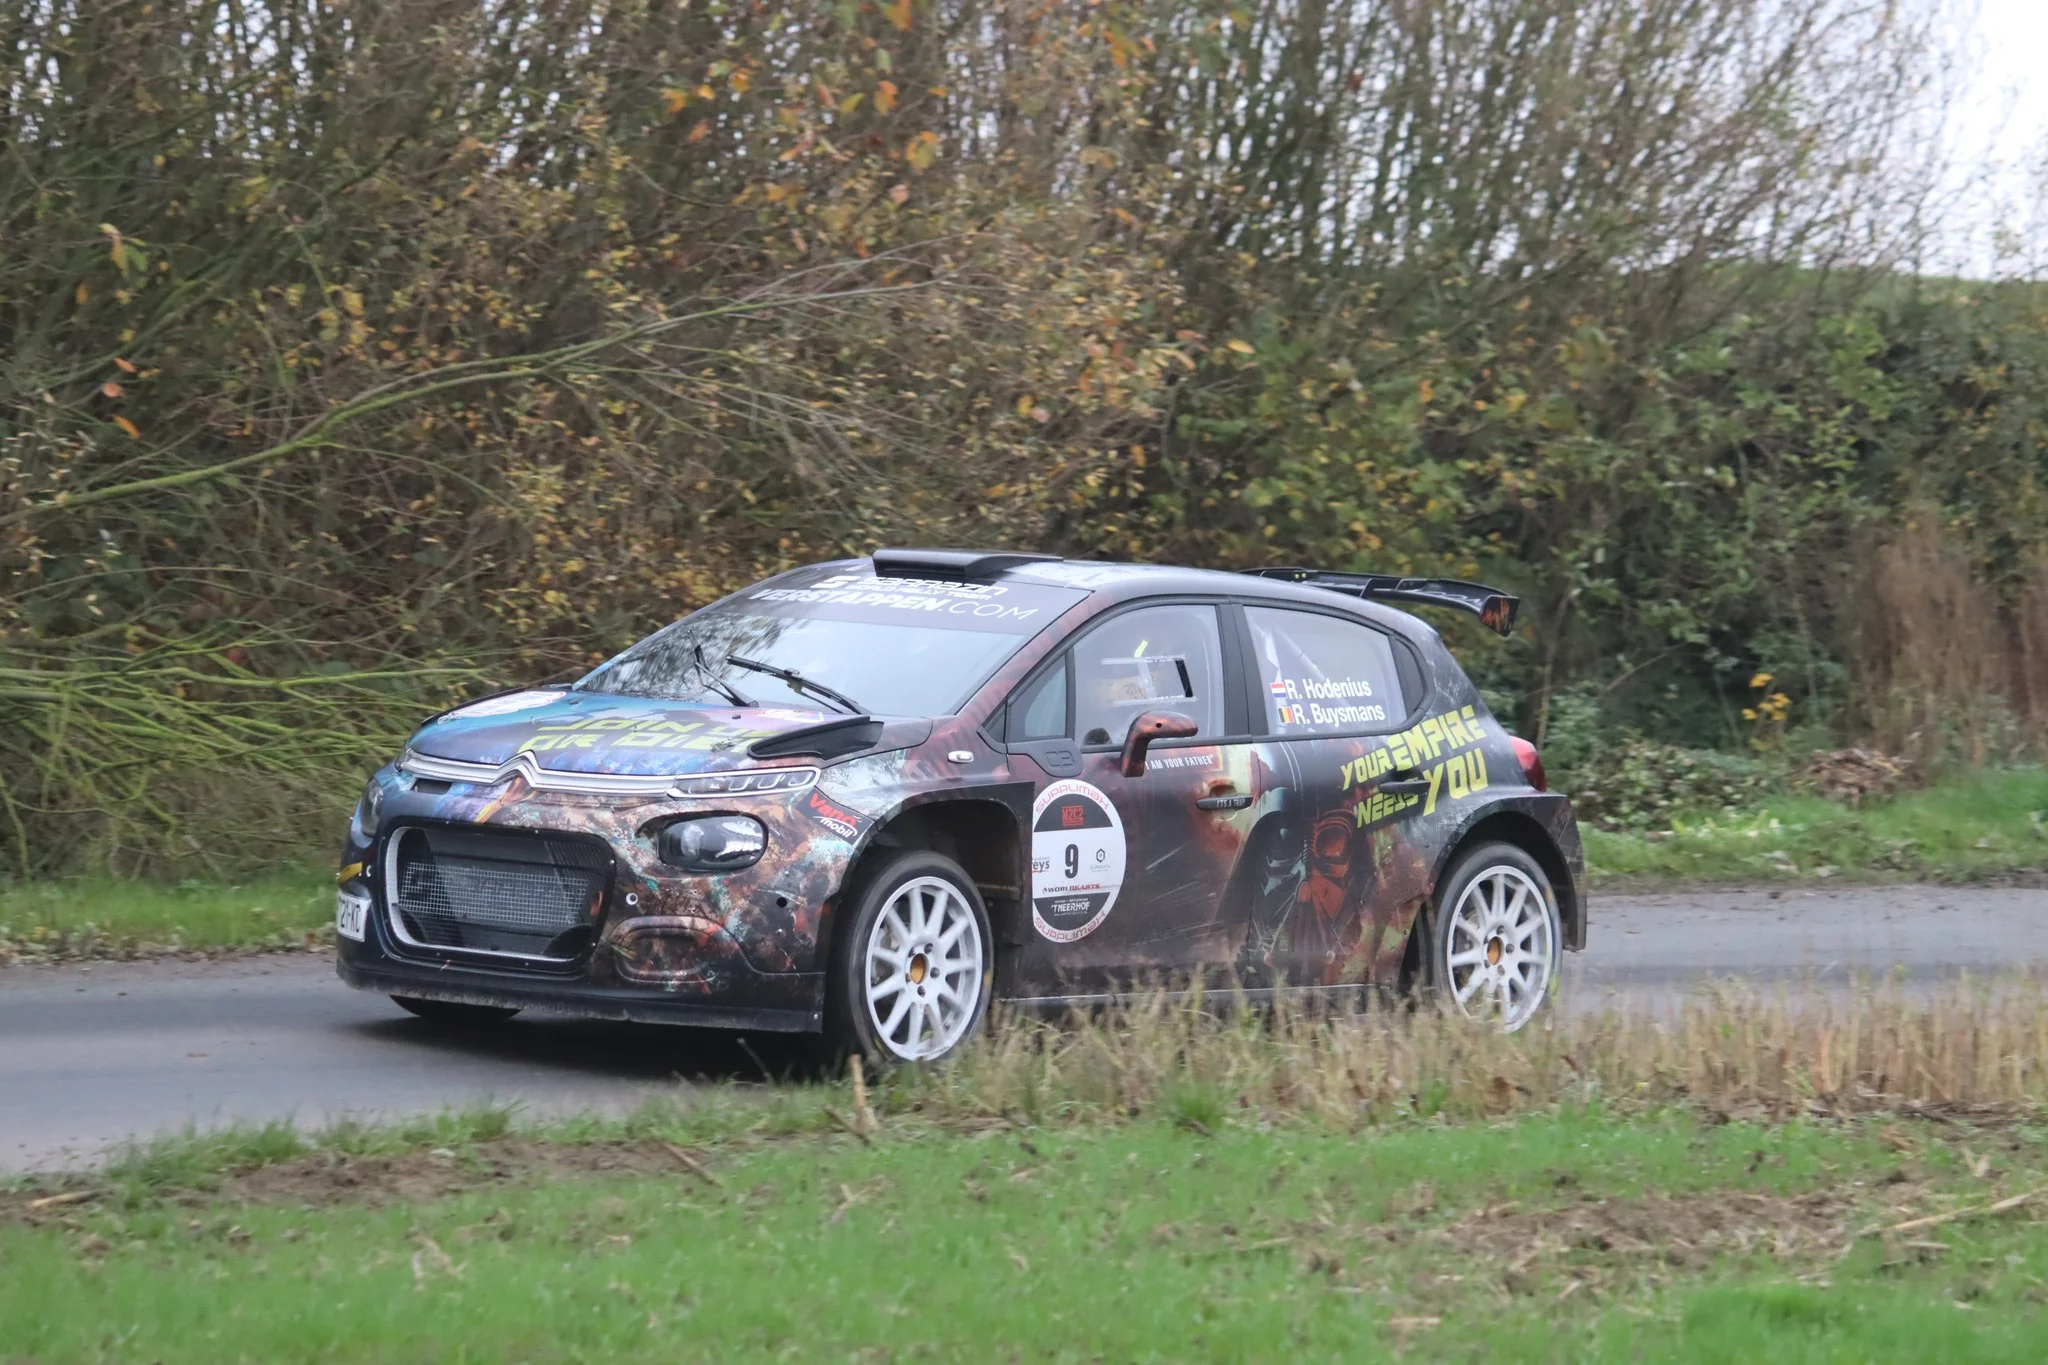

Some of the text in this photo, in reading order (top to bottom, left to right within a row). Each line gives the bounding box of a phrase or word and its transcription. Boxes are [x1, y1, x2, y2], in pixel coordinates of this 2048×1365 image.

[748, 588, 1040, 620] VERSTAPPEN.COM
[1284, 677, 1373, 699] R. Hodenius
[537, 719, 706, 733] JOIN
[1291, 703, 1386, 727] R. Buysmans
[516, 734, 607, 752] OR
[1387, 704, 1488, 772] EMPIRE
[1150, 759, 1164, 770] AM
[1163, 757, 1185, 769] YOUR
[1340, 747, 1394, 791] YOUR
[1422, 748, 1489, 817] YOU
[820, 817, 854, 838] mobil
[1032, 860, 1050, 873] eys
[1064, 844, 1079, 879] 9
